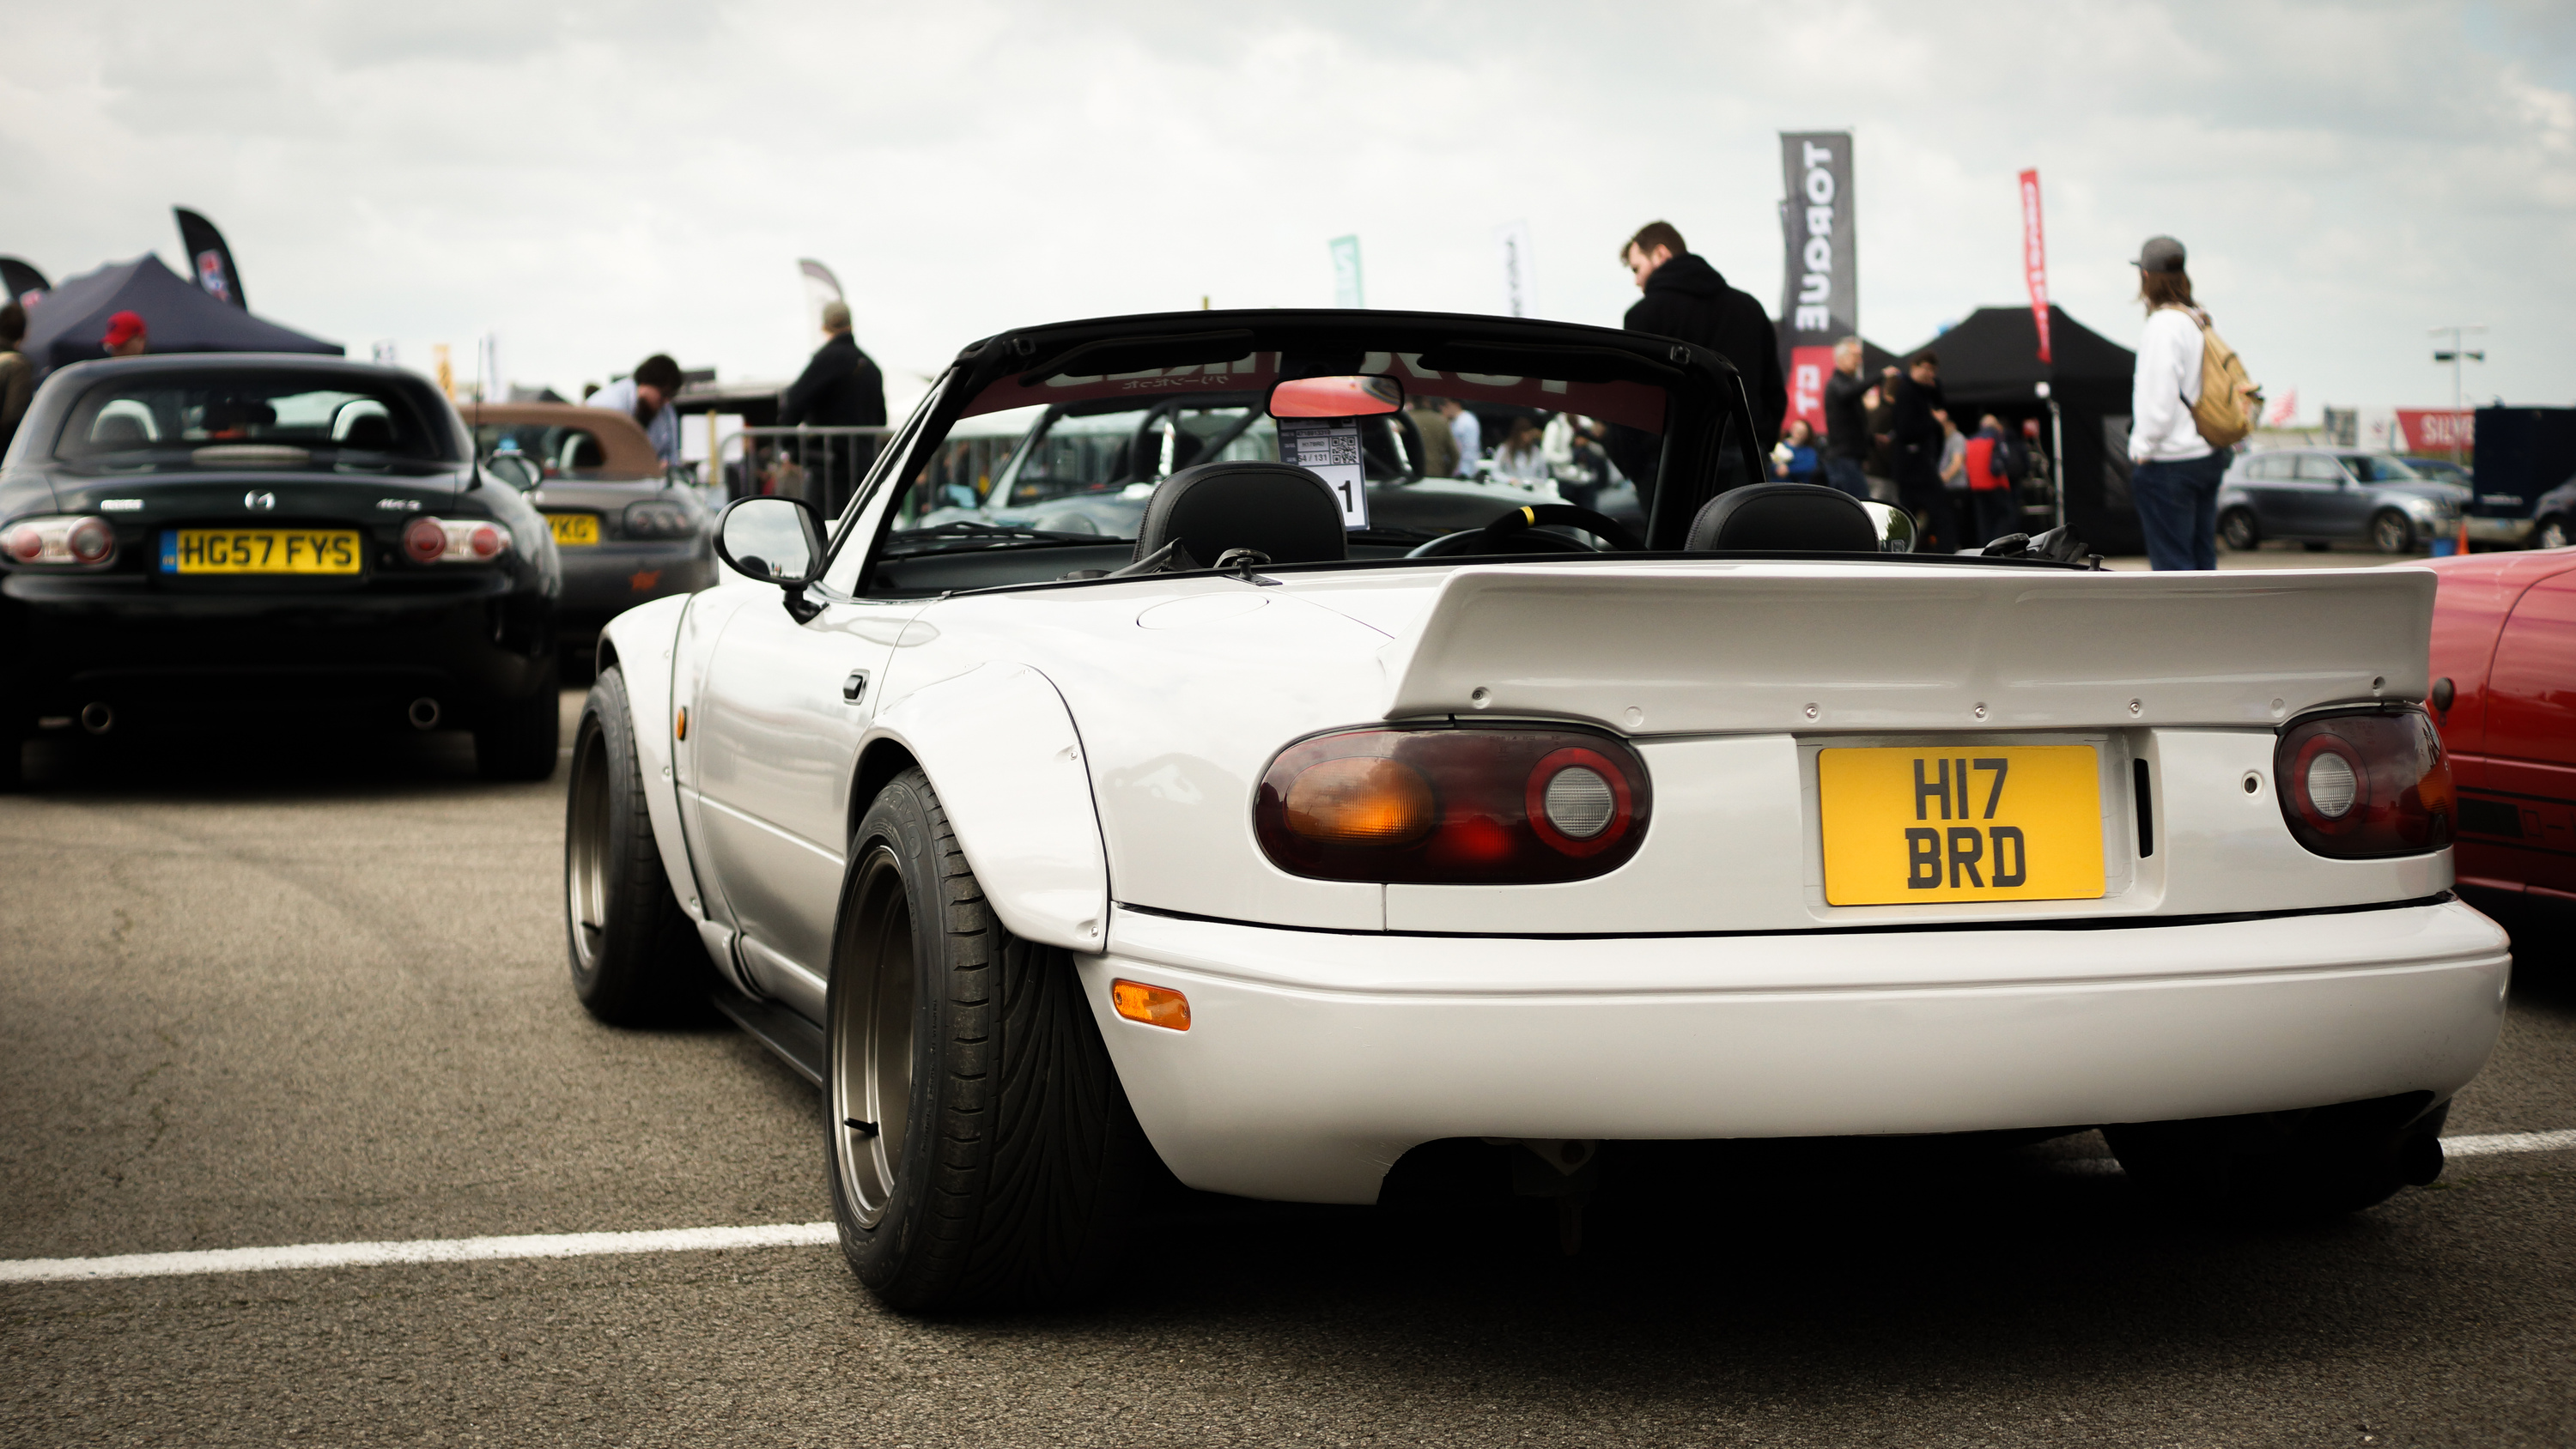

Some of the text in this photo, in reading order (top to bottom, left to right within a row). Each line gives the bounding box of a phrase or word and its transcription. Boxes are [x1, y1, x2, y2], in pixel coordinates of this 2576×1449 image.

[1314, 453, 1327, 462] 131
[550, 518, 587, 538] KG
[183, 535, 352, 567] HG57 FYS
[1913, 757, 2008, 821] H17
[1905, 826, 2026, 889] BRD
